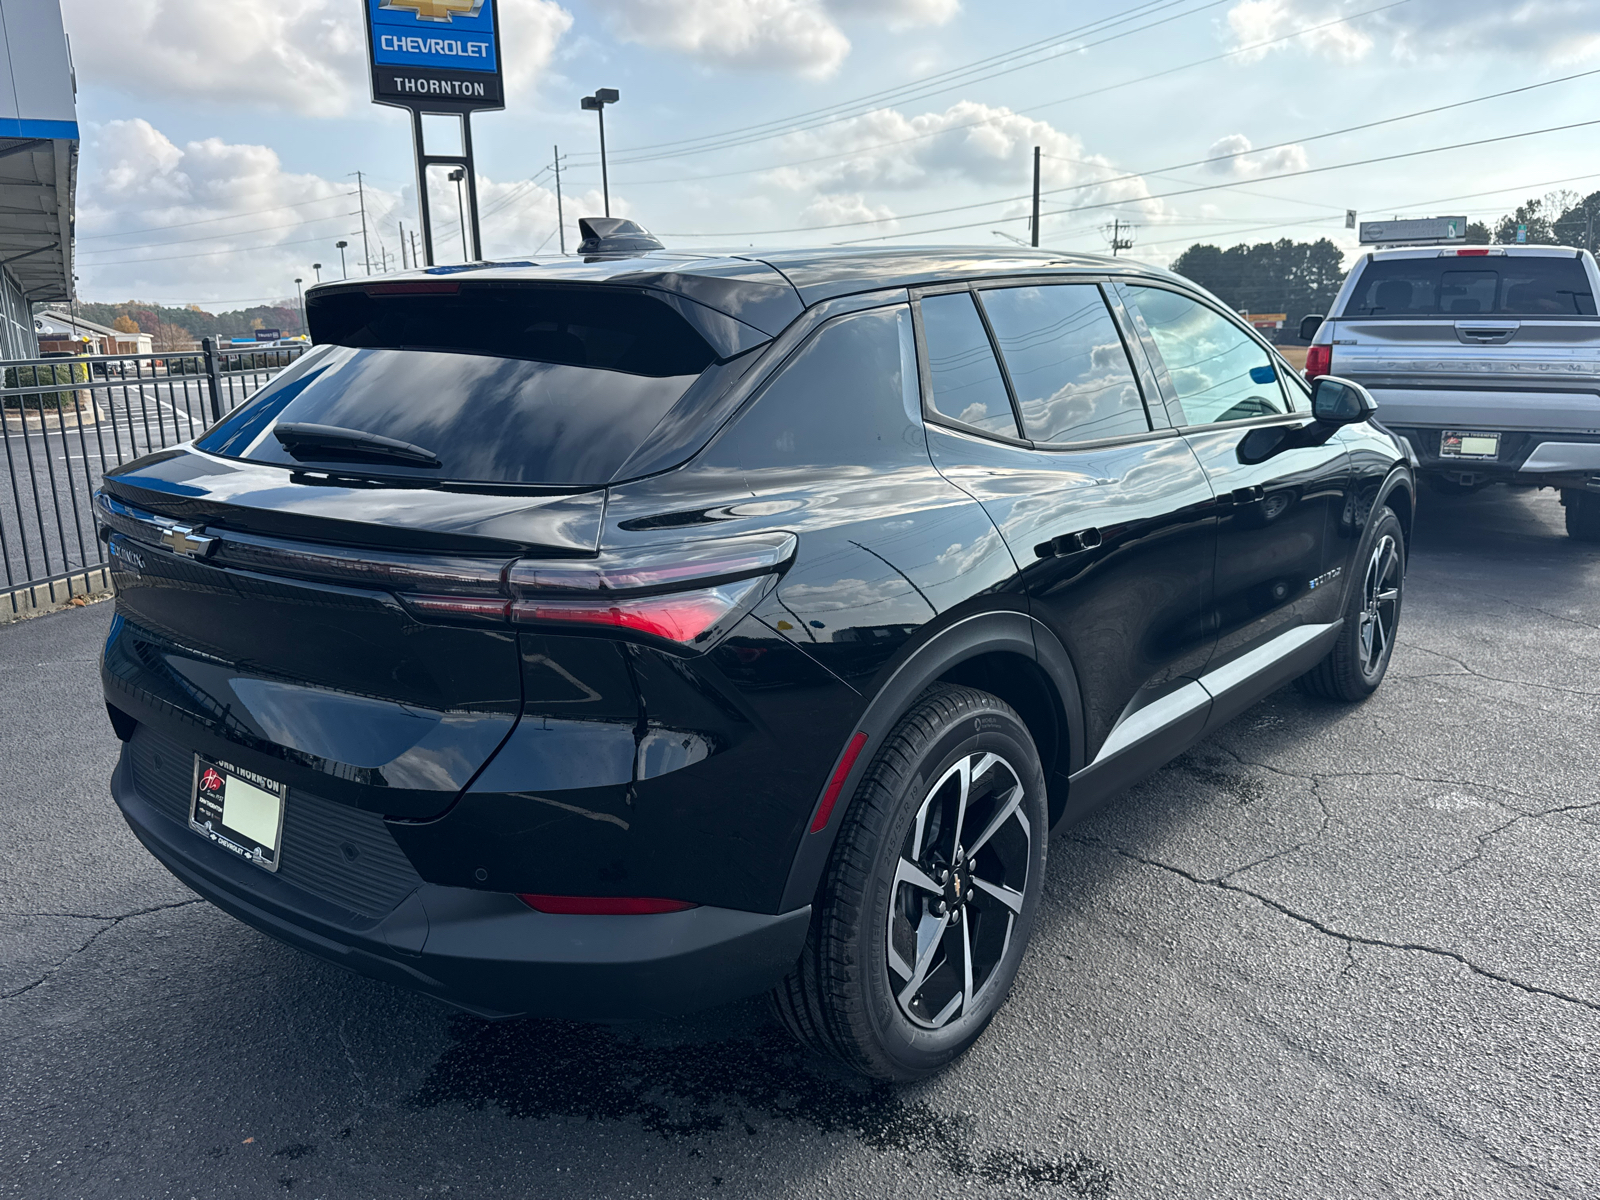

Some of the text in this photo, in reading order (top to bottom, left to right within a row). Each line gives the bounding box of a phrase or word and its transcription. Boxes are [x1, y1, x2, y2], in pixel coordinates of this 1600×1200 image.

[381, 35, 489, 58] CHEVROLET
[394, 77, 485, 96] THORNTON
[1387, 361, 1581, 372] PLATINUM
[217, 837, 244, 856] CHEVROLET
[884, 816, 905, 867] 245/55
[872, 880, 887, 999] MICHELIN
